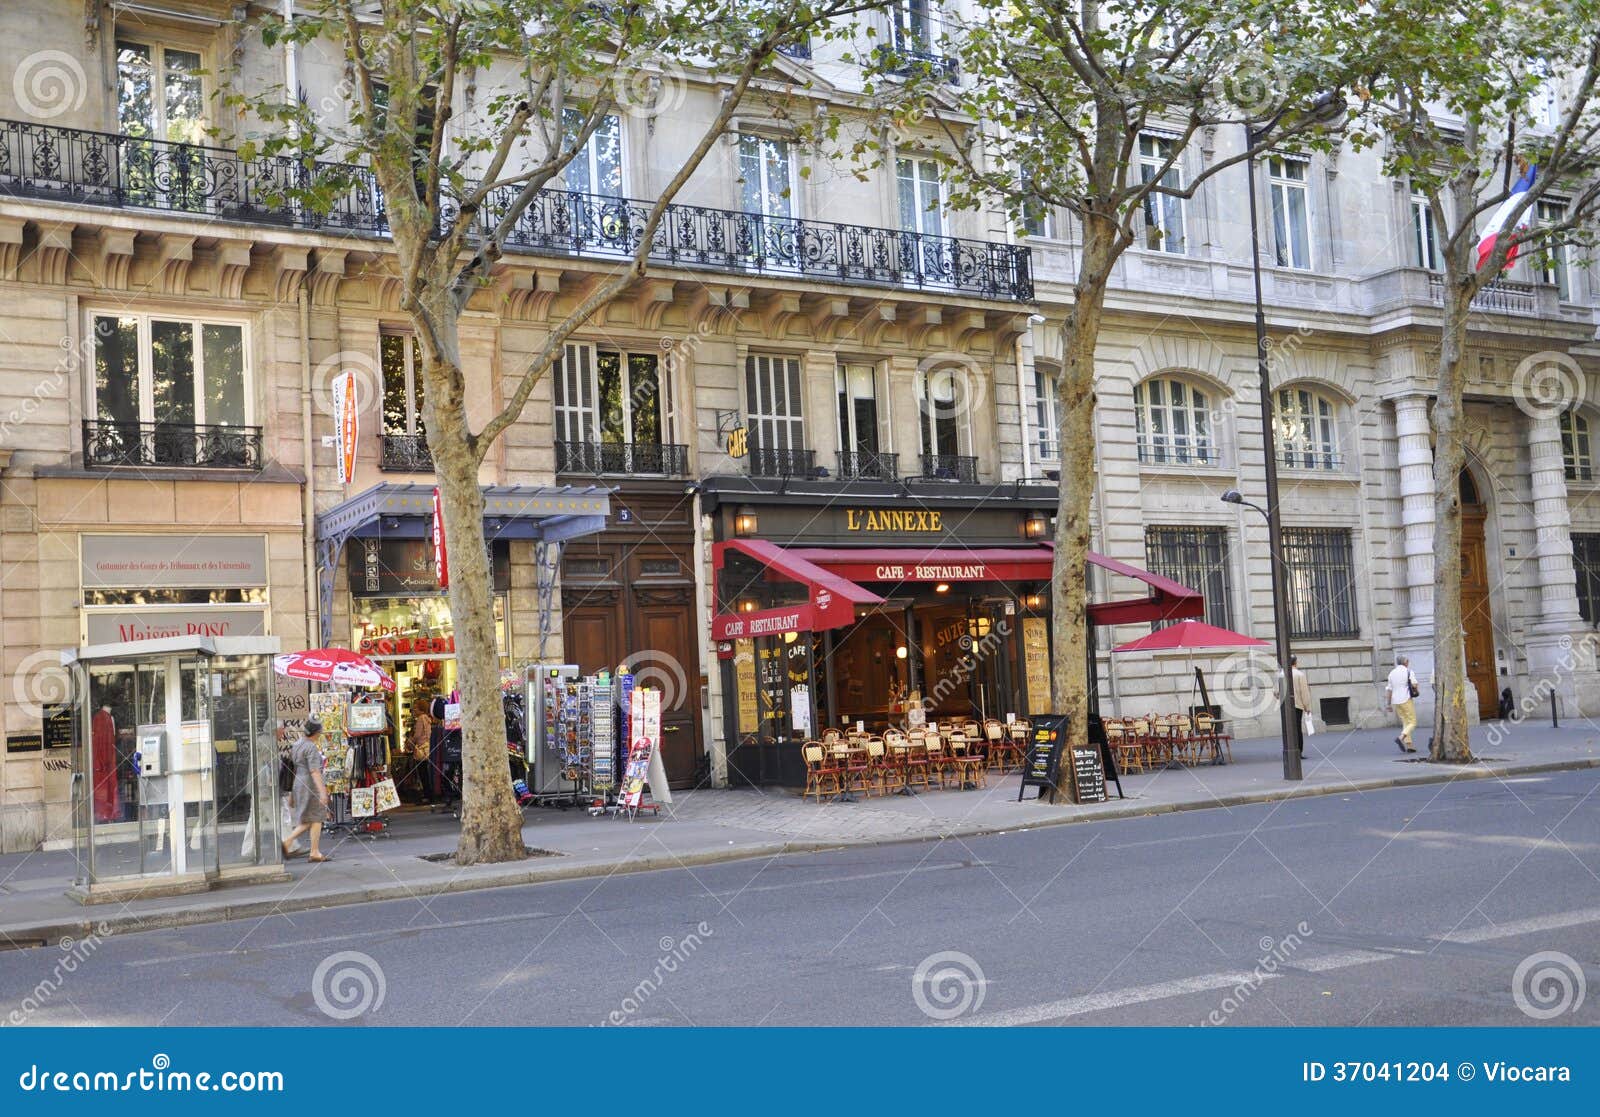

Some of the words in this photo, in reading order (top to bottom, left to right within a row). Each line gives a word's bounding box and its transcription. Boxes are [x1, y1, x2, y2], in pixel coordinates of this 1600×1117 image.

[621, 510, 628, 520] 5
[847, 509, 943, 532] L'ANNEXE
[432, 494, 443, 579] TABAC
[876, 566, 905, 579] CAFE
[915, 565, 985, 579] RESTAURANT
[725, 620, 745, 636] CAFE
[749, 613, 800, 634] RESTAURANT
[937, 621, 966, 647] SUZE
[788, 645, 806, 659] CAFE
